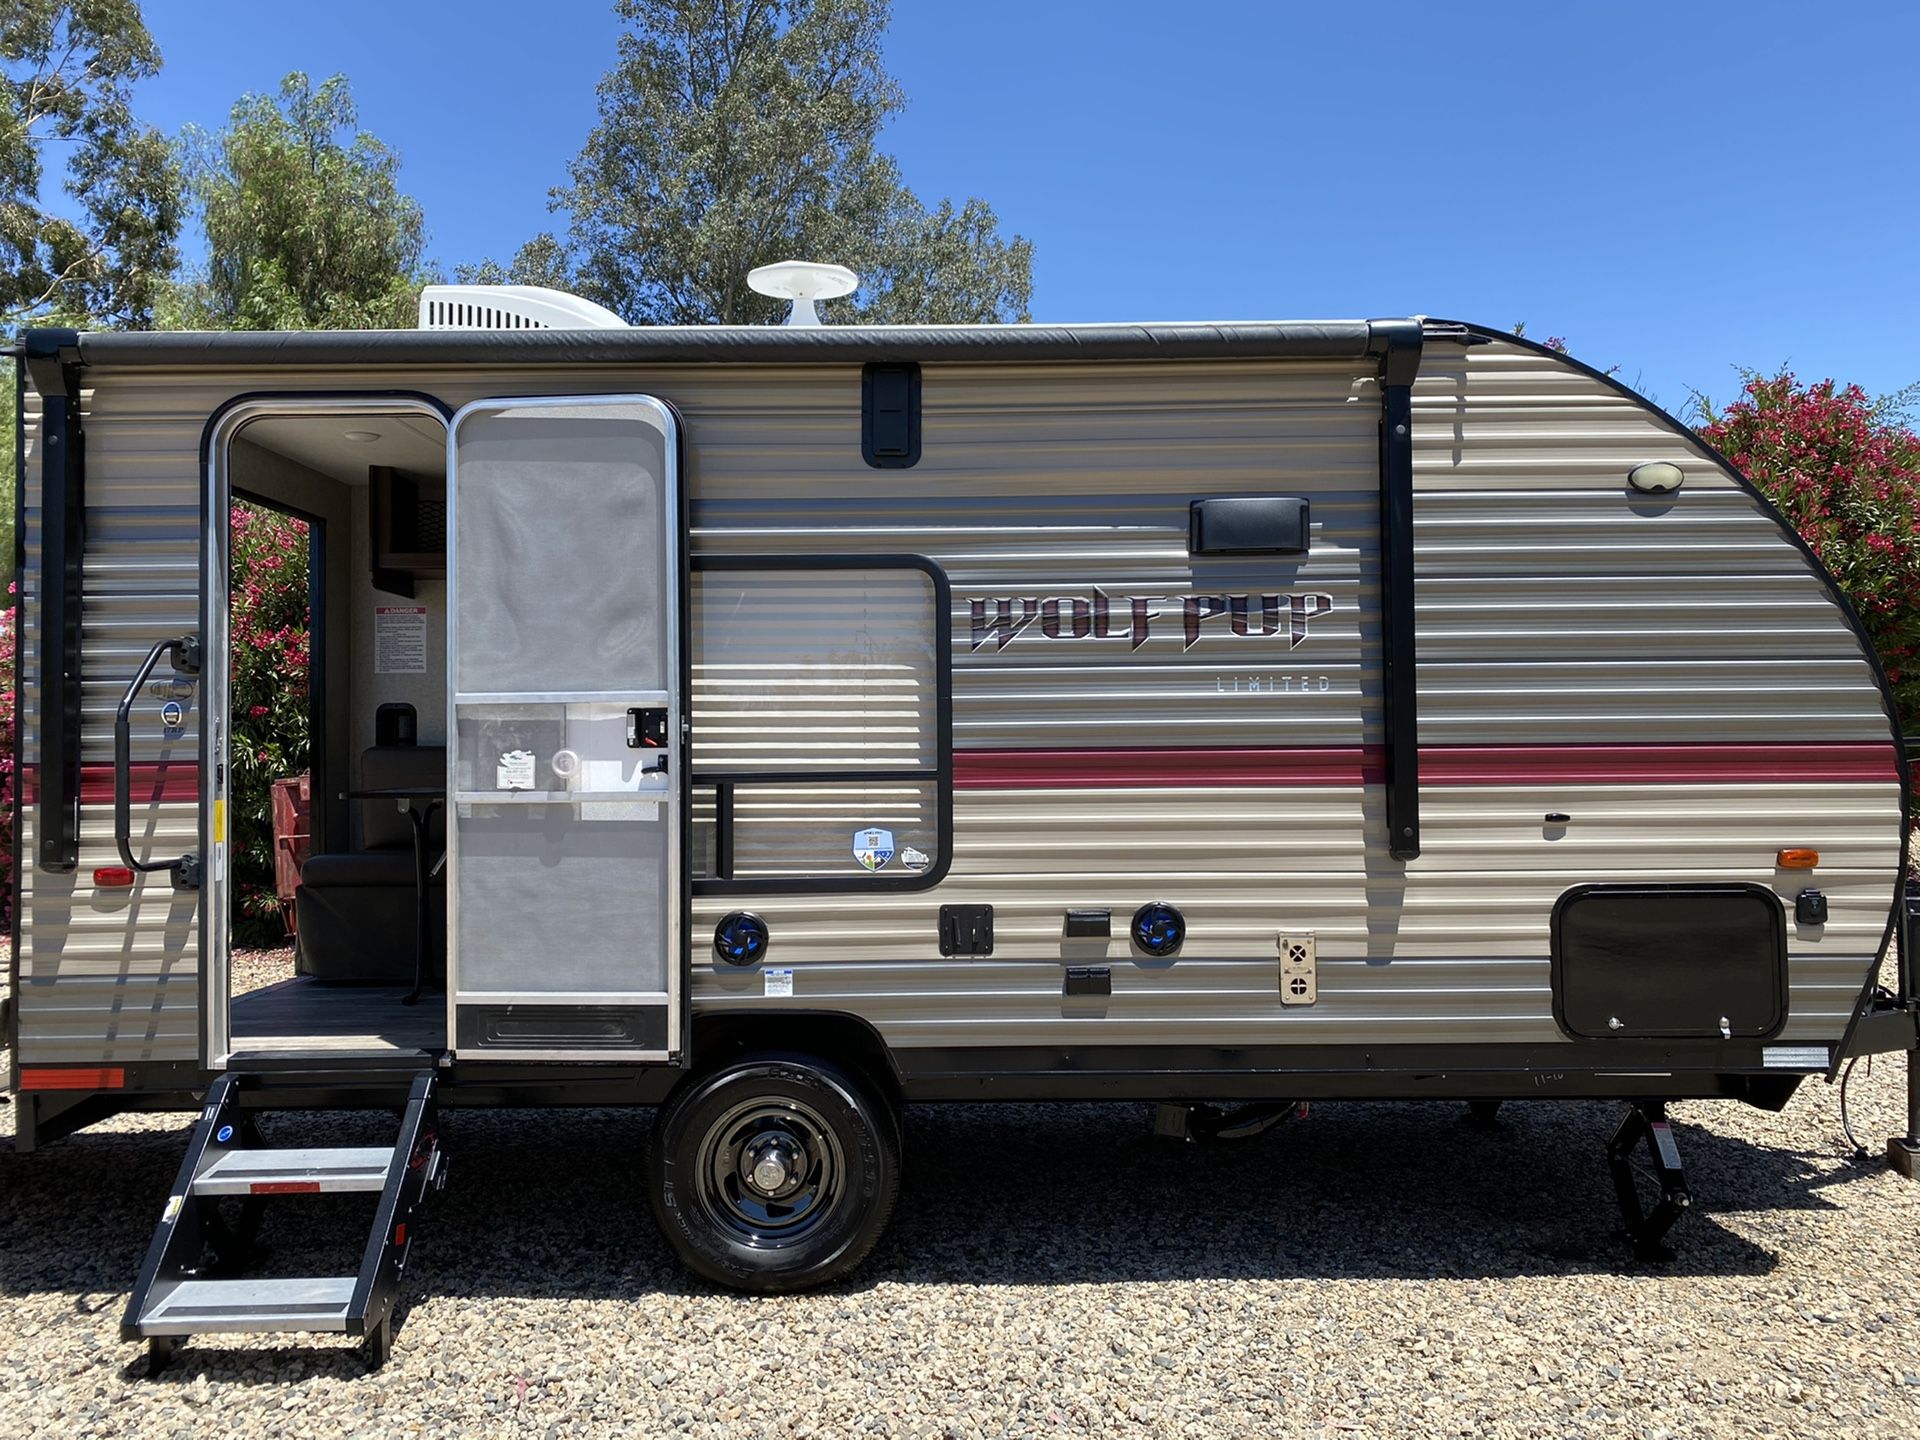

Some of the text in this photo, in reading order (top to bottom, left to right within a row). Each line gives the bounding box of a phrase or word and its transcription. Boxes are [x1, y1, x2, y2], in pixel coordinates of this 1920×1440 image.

[966, 585, 1333, 654] WOLF PUP
[1217, 676, 1330, 692] LIMITED
